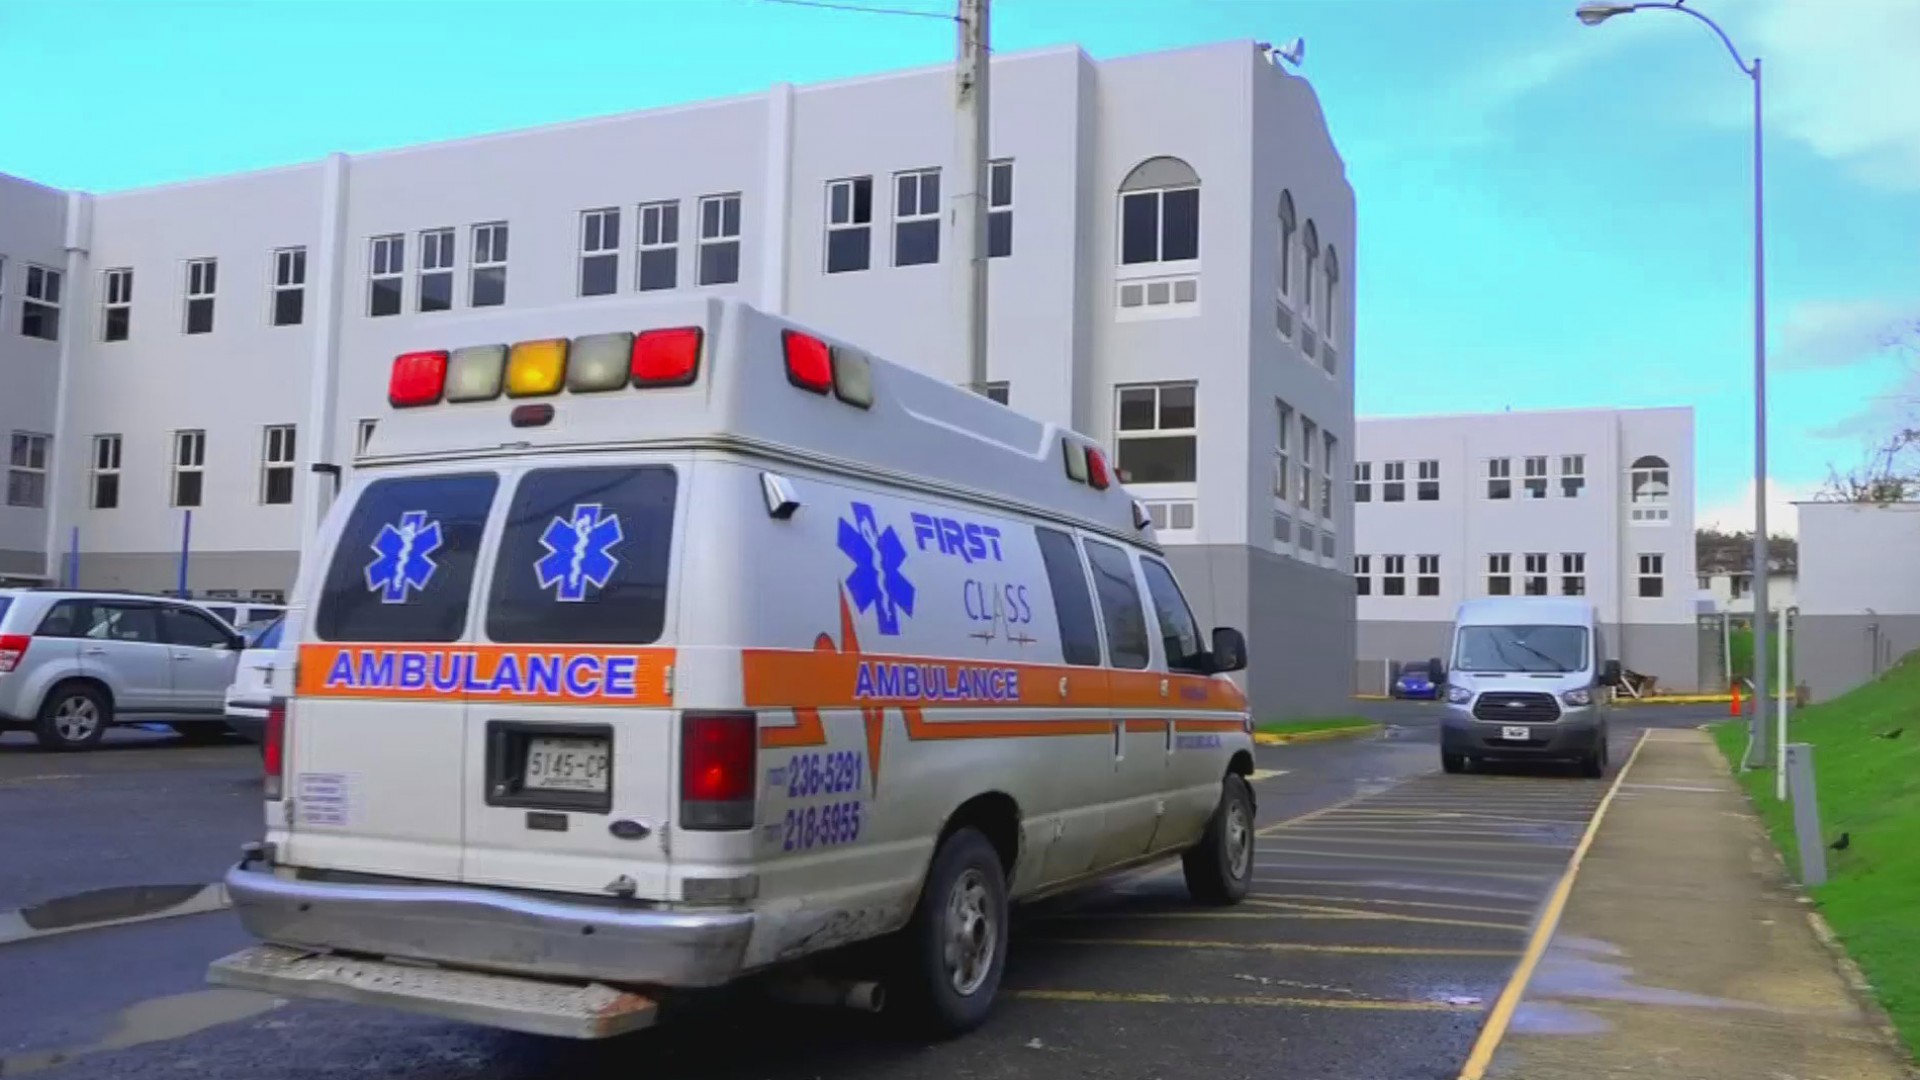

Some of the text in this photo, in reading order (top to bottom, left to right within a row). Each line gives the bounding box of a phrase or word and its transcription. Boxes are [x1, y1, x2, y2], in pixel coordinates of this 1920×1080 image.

[911, 512, 1002, 562] FIRST
[963, 579, 1031, 623] CLASS
[325, 650, 638, 698] AMBULANCE
[854, 663, 1020, 700] AMBULANCE
[788, 751, 862, 797] 236-5291
